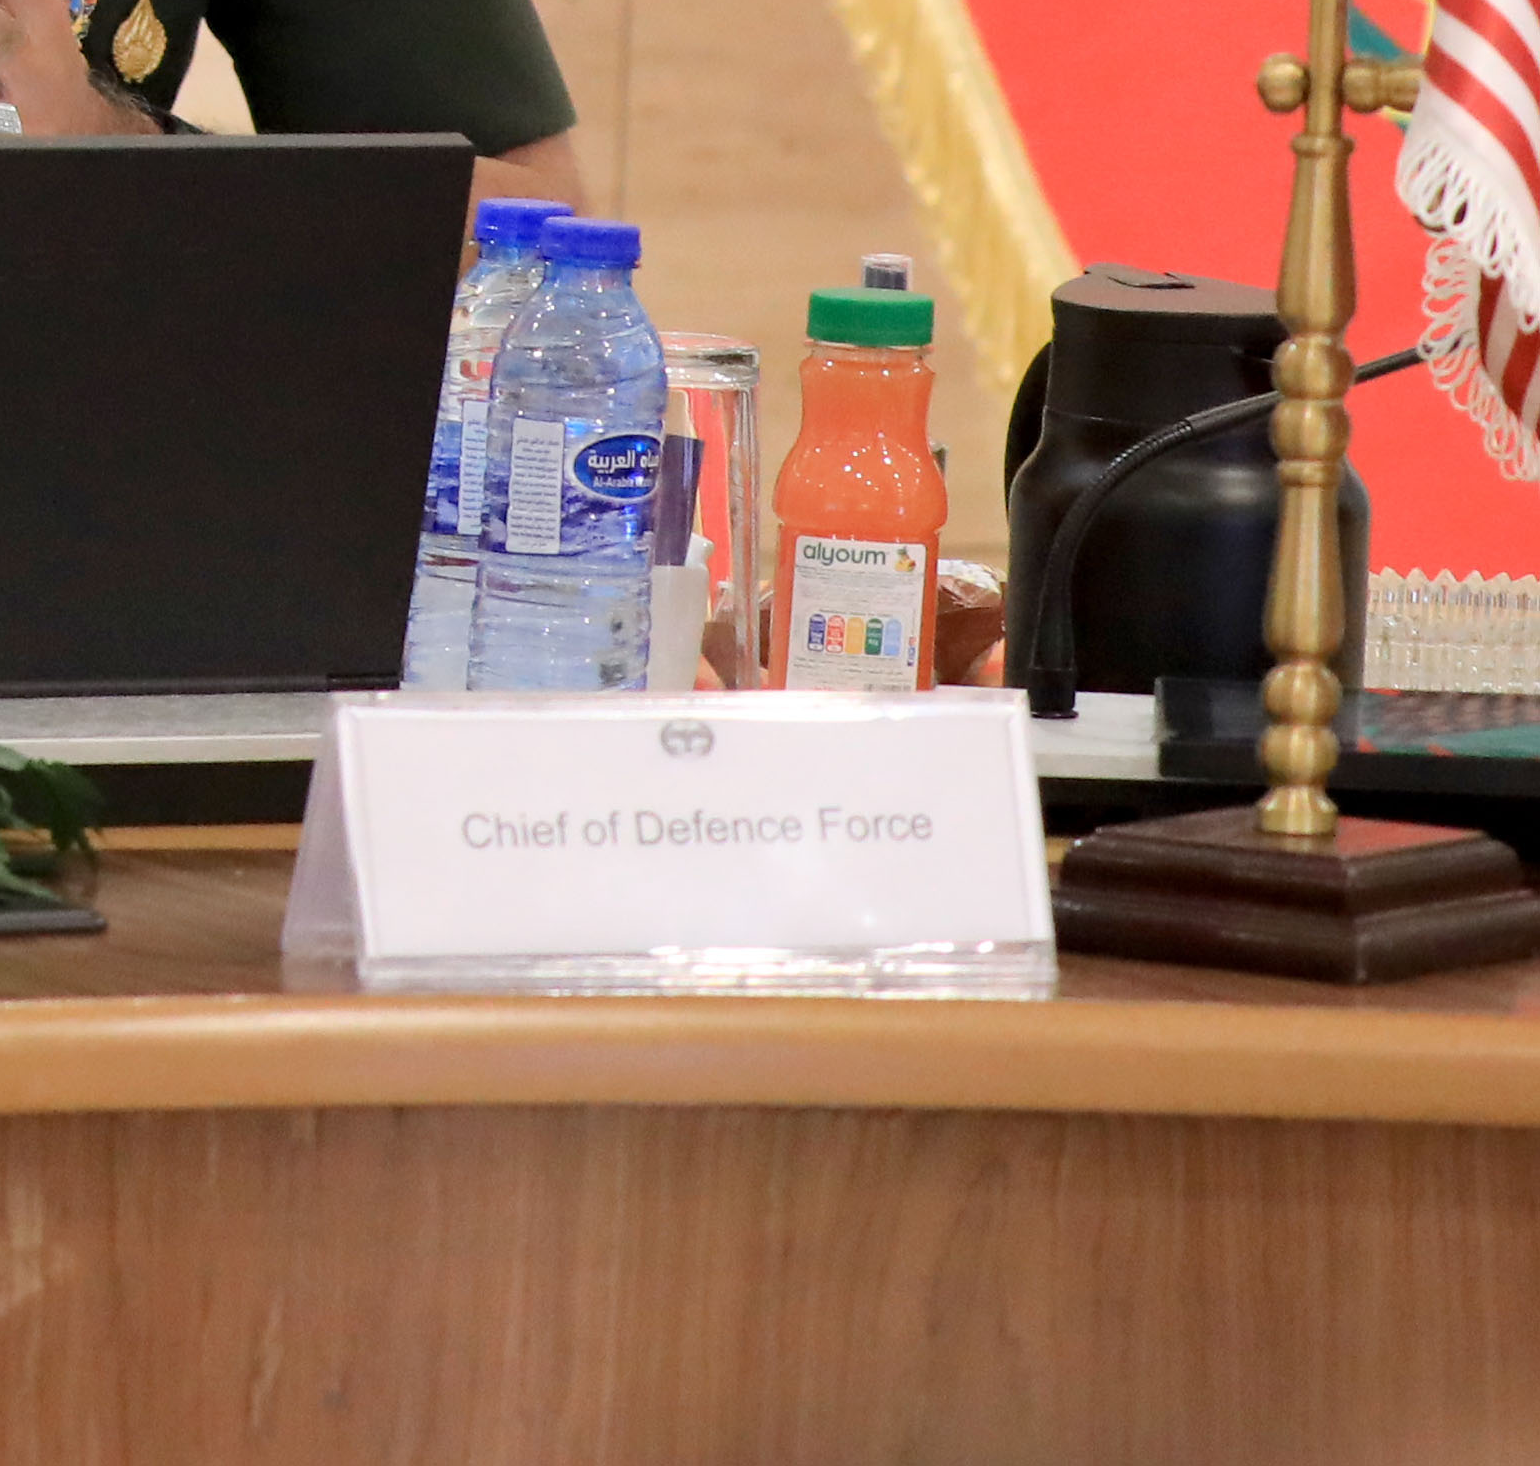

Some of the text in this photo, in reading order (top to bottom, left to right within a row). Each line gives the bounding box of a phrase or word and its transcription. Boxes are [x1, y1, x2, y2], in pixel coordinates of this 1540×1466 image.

[586, 448, 637, 475] العربية
[803, 542, 886, 566] alyoum
[462, 805, 934, 850] Chief of Defence Force
